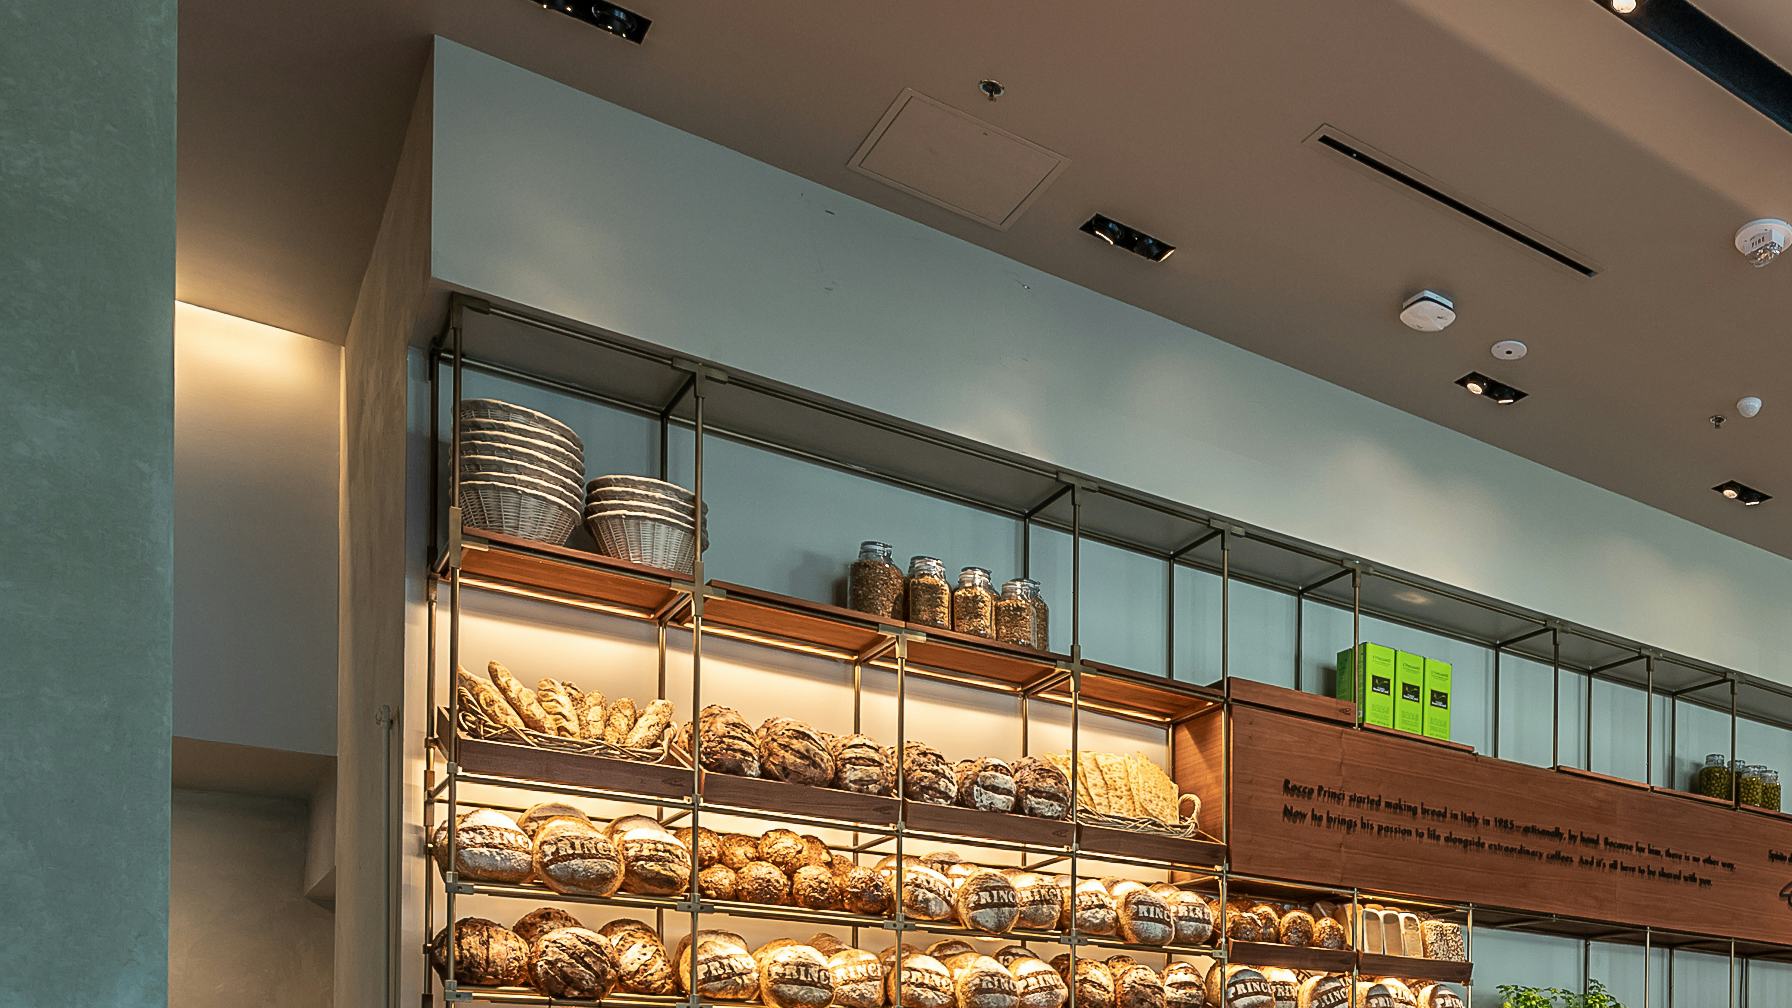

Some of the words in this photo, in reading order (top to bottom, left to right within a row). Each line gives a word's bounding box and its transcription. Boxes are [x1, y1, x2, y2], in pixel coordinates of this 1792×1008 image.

[1282, 803, 1308, 822] Now
[1311, 807, 1324, 824] he
[1327, 810, 1358, 832] brings
[1360, 816, 1375, 831] his
[1377, 822, 1412, 840] passion
[1415, 827, 1425, 839] to
[1427, 827, 1441, 842] life
[1444, 831, 1486, 850] alongside
[1488, 842, 1543, 861] extraordinary
[1579, 855, 1595, 868] And
[1608, 859, 1619, 871] all
[1620, 861, 1636, 873] here
[1638, 865, 1646, 875] to
[1647, 864, 1656, 876] be
[1658, 867, 1682, 882] shared
[1683, 871, 1698, 883] with
[1283, 778, 1314, 797] Rocco
[1317, 784, 1346, 802] Princi
[1348, 793, 1382, 809] started
[1384, 798, 1418, 817] making
[1420, 802, 1448, 819] bread
[1450, 809, 1459, 822] in
[1460, 811, 1480, 827] Italy
[1482, 815, 1491, 828] in
[1568, 829, 1579, 845] by
[1604, 836, 1634, 853] Because
[1636, 841, 1646, 855] for
[1665, 847, 1683, 861] there
[1684, 850, 1690, 862] is
[1702, 854, 1720, 866] other
